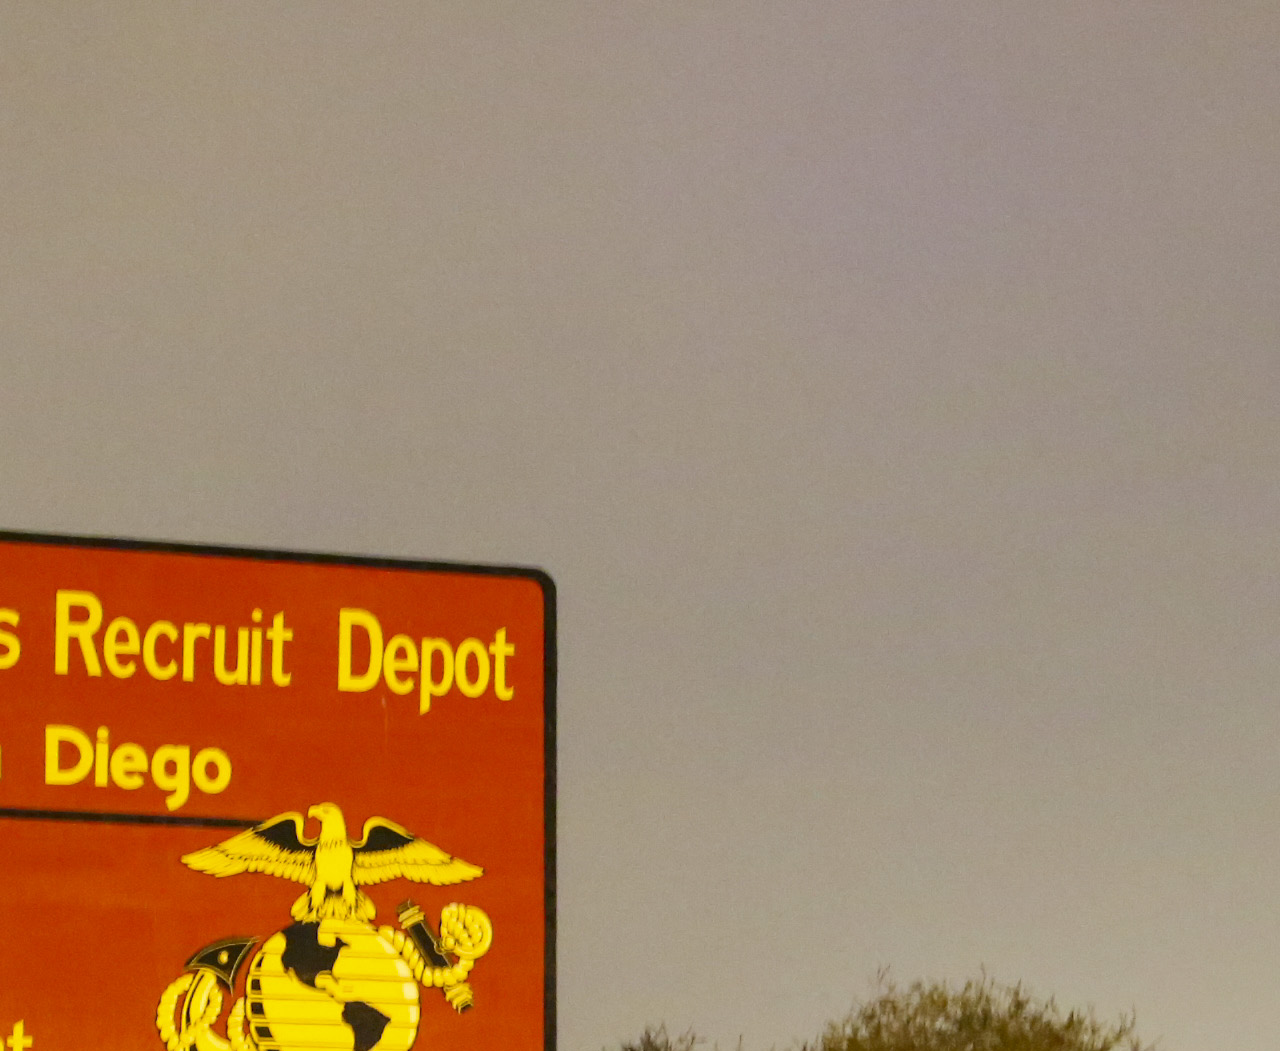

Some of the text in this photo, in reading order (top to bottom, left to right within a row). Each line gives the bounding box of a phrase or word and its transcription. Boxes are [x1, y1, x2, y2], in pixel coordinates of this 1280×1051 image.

[53, 589, 295, 688] Recruit
[336, 607, 516, 716] Depot
[44, 723, 233, 812] Diego
